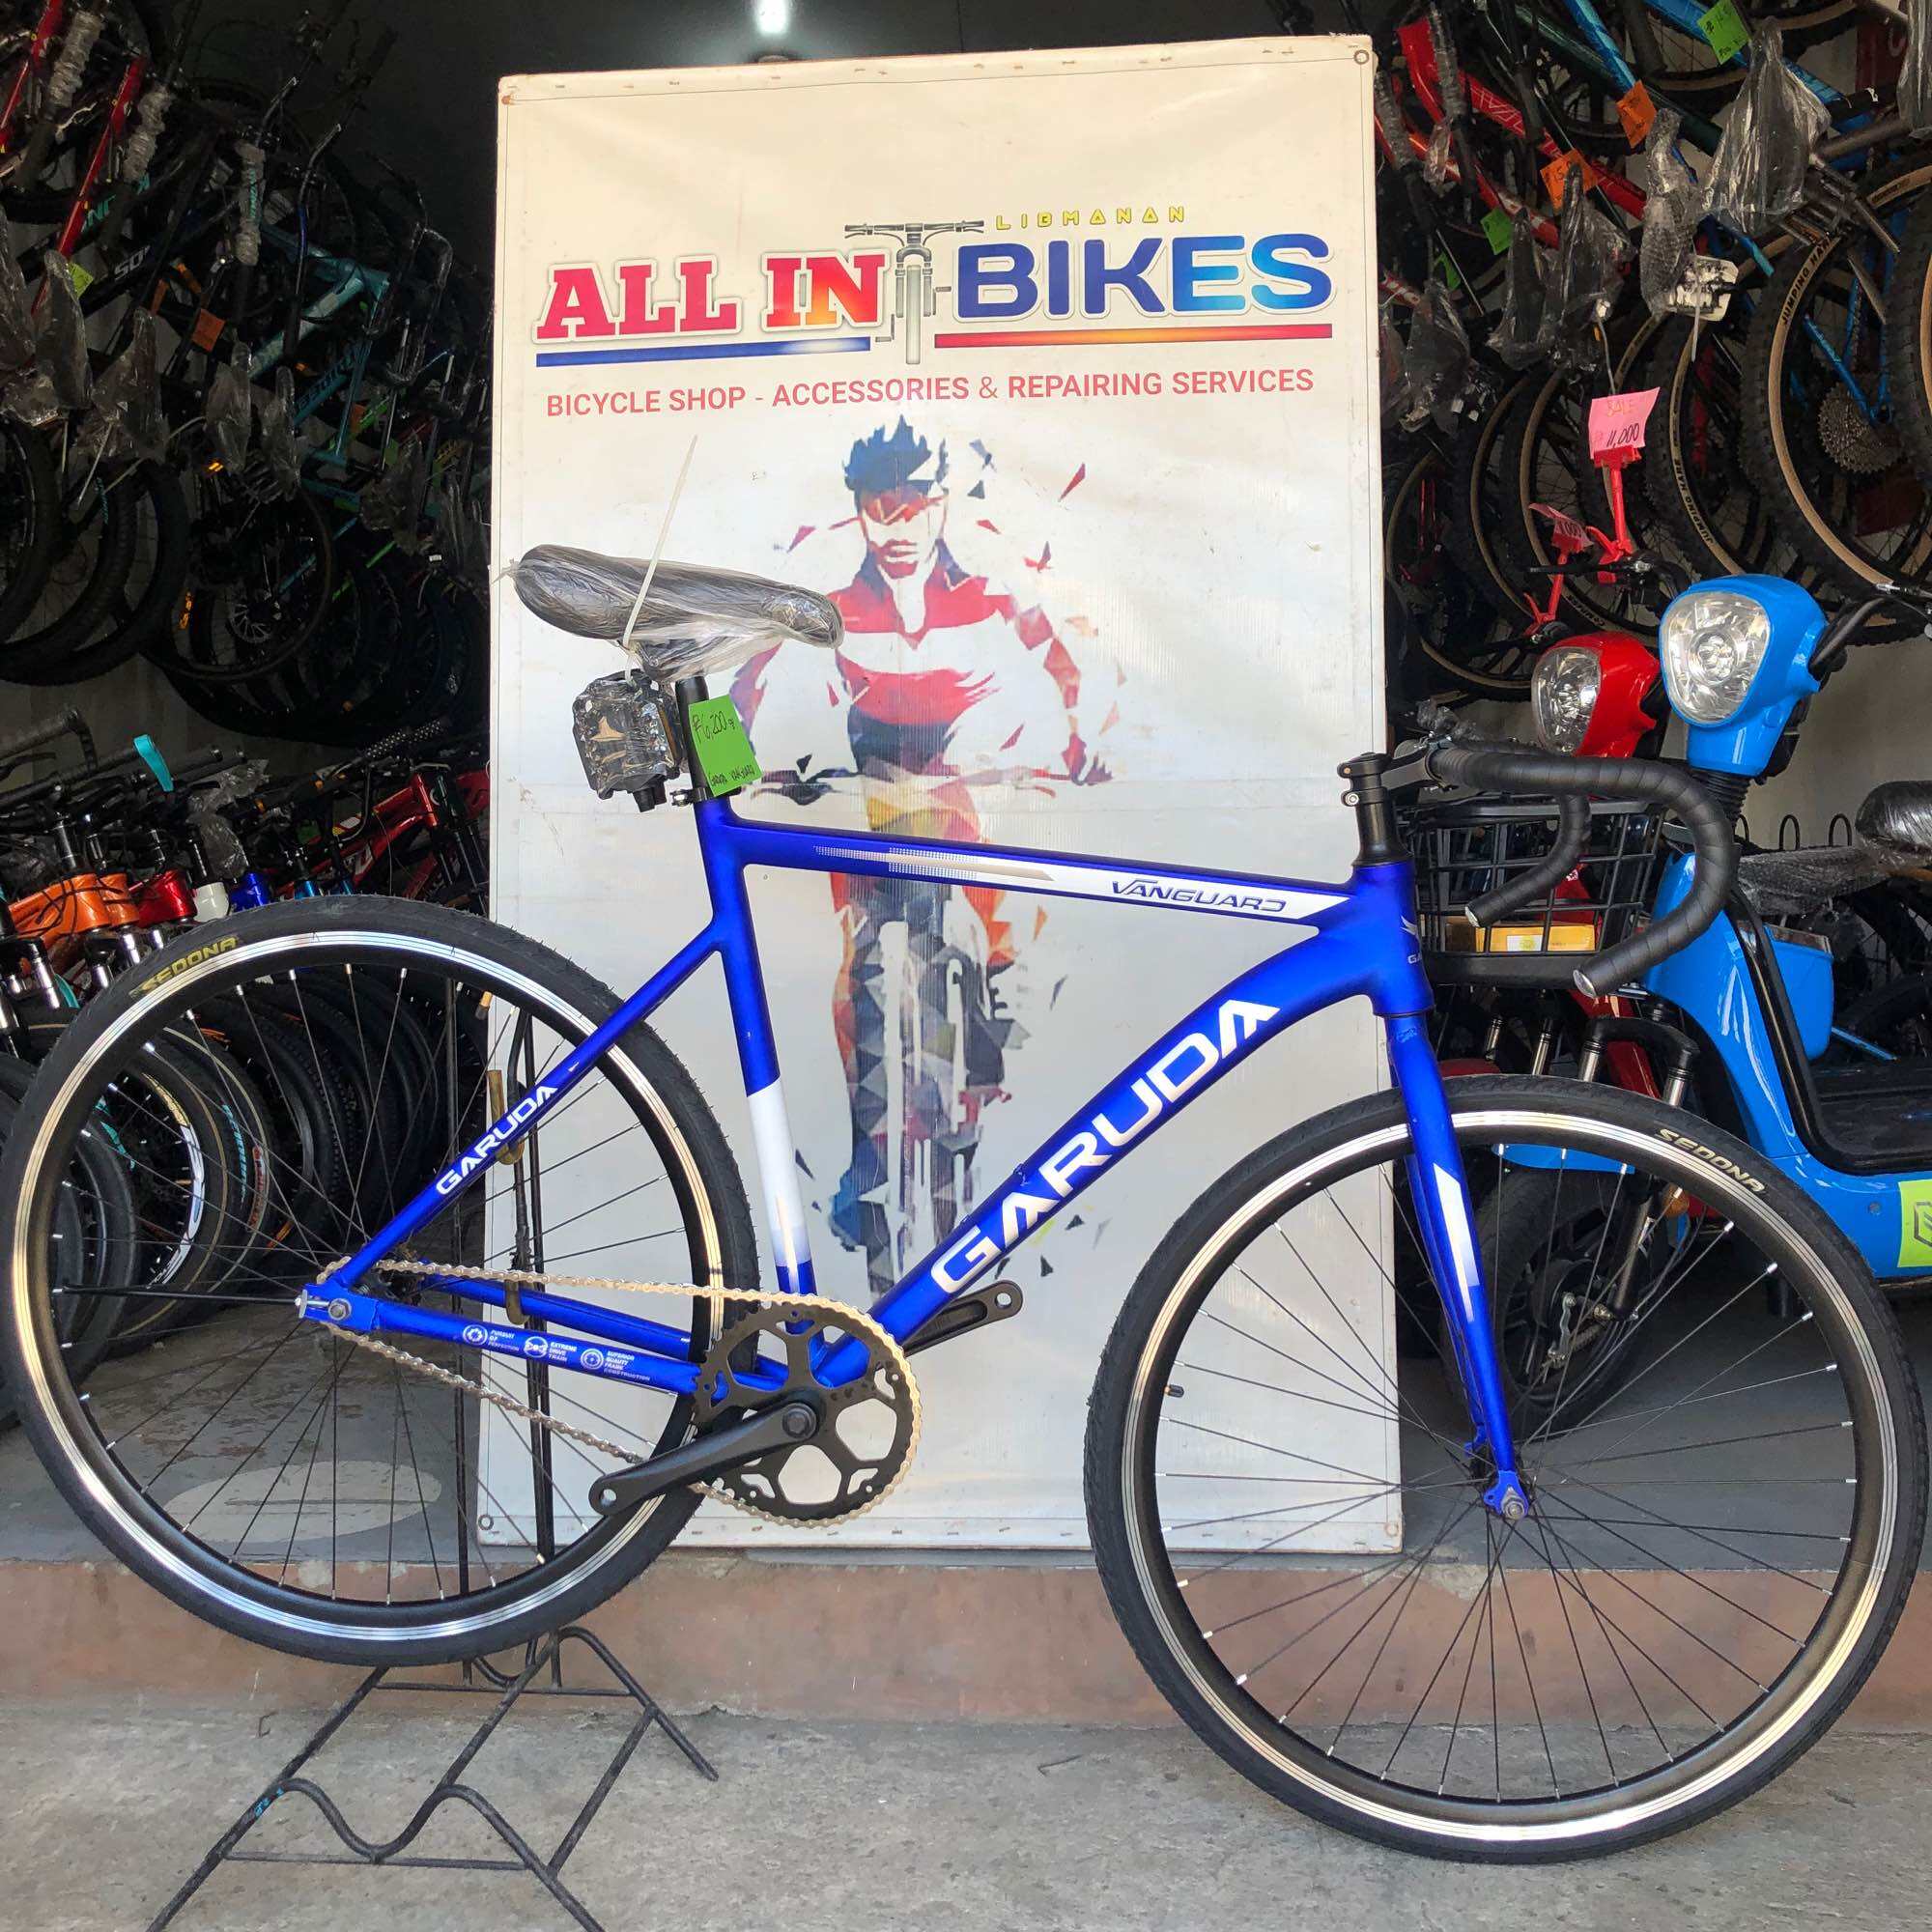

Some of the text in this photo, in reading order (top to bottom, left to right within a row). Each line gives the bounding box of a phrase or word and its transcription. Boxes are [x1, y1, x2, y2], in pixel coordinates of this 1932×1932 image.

[995, 206, 1186, 231] LIBMANAN
[535, 233, 1334, 340] ALL IN BIKES
[547, 389, 662, 417] BICYCLE
[668, 385, 747, 412] SHOP
[772, 374, 970, 408] ACCESSORIES
[978, 376, 999, 399] &
[1008, 372, 1163, 399] REPAIRING
[1172, 368, 1315, 395] SERVICES
[1112, 878, 1287, 913] VANGUARD
[436, 1086, 558, 1195] GARUDA
[930, 999, 1281, 1294] GARUDA
[1660, 1128, 1766, 1192] SEDONA
